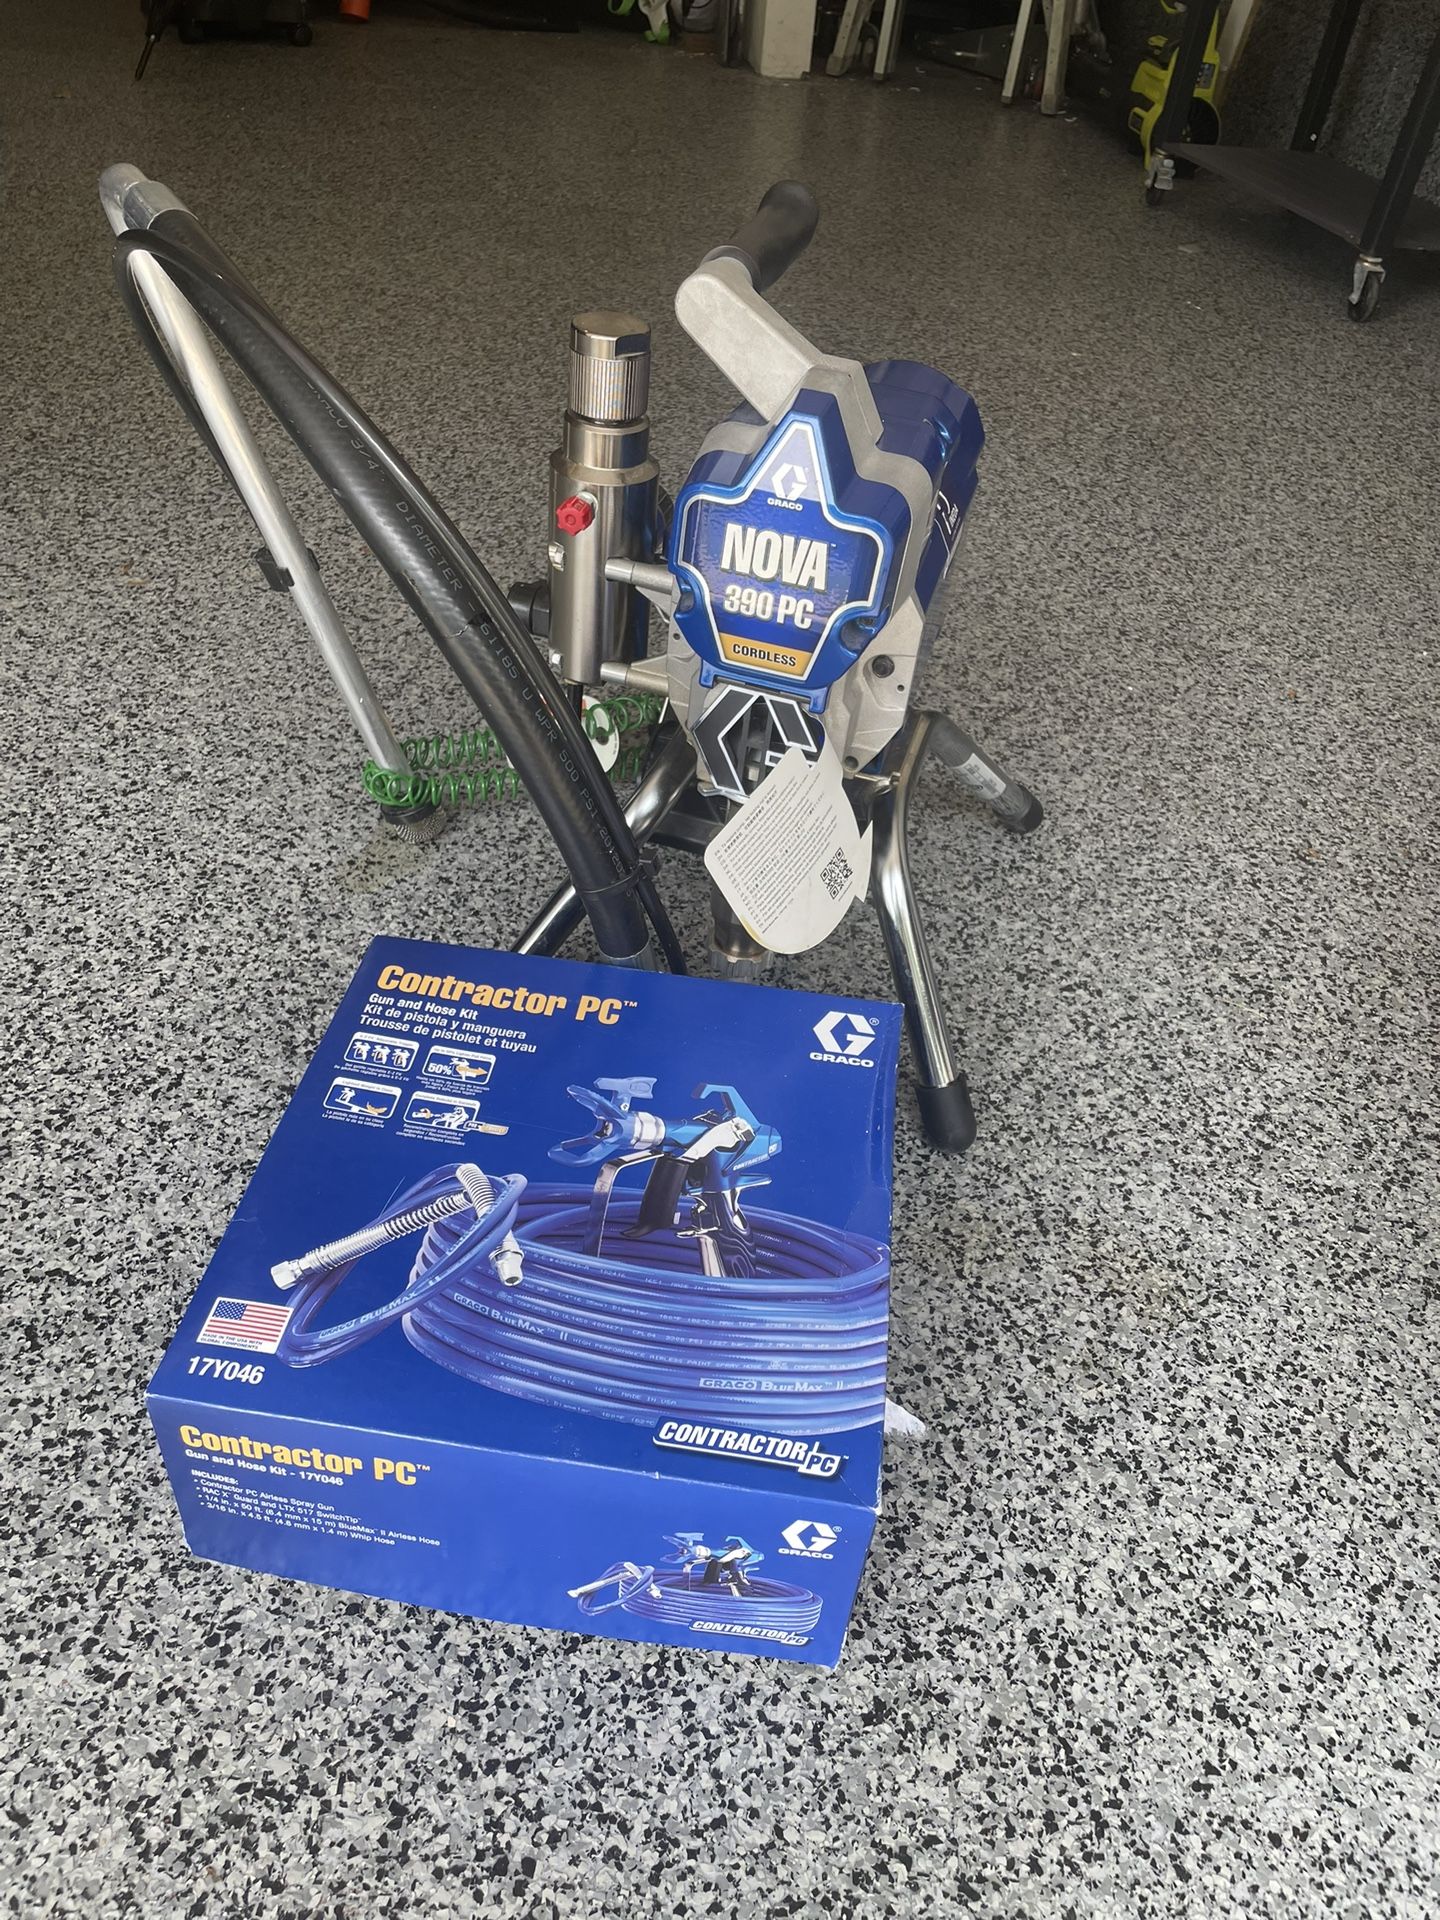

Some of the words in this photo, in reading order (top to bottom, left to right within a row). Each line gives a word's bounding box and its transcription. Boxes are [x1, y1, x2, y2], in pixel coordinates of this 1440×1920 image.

[767, 497, 803, 511] GRACO
[720, 523, 828, 592] NOVA
[723, 584, 771, 621] 390
[776, 594, 814, 630] PC
[396, 501, 462, 592] DIAMETER
[480, 623, 518, 679] 61185
[535, 708, 558, 742] WPR
[559, 750, 580, 783] 500
[580, 788, 598, 819] PSI
[732, 644, 796, 667] CORDLESS
[369, 993, 394, 1006] Gun
[397, 998, 422, 1010] and
[425, 1003, 457, 1017] Hose
[459, 1008, 479, 1020] Kit
[377, 964, 567, 1017] Contractor
[360, 1015, 410, 1032] Trousse
[413, 1024, 430, 1036] de
[432, 1029, 481, 1046] pistolet
[484, 1038, 497, 1047] et
[500, 1039, 537, 1053] tuyau
[363, 1004, 383, 1016] Kit
[385, 1006, 401, 1018] de
[403, 1011, 447, 1027] pistola
[450, 1020, 459, 1030] y
[462, 1022, 527, 1040] manguera
[427, 1062, 452, 1075] 50%
[809, 1052, 874, 1068] GRACO
[222, 1340, 259, 1350] COMPONENTS
[455, 1294, 488, 1313] GRACO
[560, 1331, 568, 1341] II
[594, 1343, 645, 1359] PERFORMANCE
[650, 1354, 683, 1364] AIRLESS
[686, 1359, 711, 1367] PAINT
[186, 1355, 266, 1386] 17Y046
[703, 1379, 755, 1390] GRACO
[836, 1380, 844, 1390] II
[621, 1391, 641, 1400] MADE
[179, 1425, 362, 1476] Contractor
[658, 1420, 810, 1461] CONTRACTOR
[805, 1453, 838, 1474] PC
[185, 1449, 209, 1461] Gun
[212, 1456, 234, 1466] and
[237, 1460, 267, 1472] Hose
[269, 1465, 287, 1476] Kit
[299, 1471, 344, 1486] 17Y046
[191, 1469, 239, 1485] INCLUDES:
[200, 1479, 244, 1494] Contractor
[245, 1488, 258, 1497] PC
[260, 1492, 289, 1504] Airless
[290, 1498, 315, 1509] Spray
[317, 1502, 335, 1512] Gun
[202, 1487, 220, 1496] RAC
[233, 1494, 259, 1505] Guard
[261, 1500, 277, 1508] and
[278, 1503, 296, 1512] LTX
[205, 1495, 219, 1503] 1/4
[241, 1503, 252, 1511] 50
[284, 1513, 301, 1521] mm
[325, 1520, 336, 1528] m)
[388, 1531, 417, 1542] Airless
[419, 1536, 441, 1546] Hose
[228, 1507, 239, 1515] in.
[294, 1522, 311, 1531] mm
[321, 1526, 334, 1535] 1.4
[336, 1529, 348, 1538] m)
[350, 1531, 372, 1542] Whip
[374, 1536, 395, 1546] Hose
[778, 1548, 834, 1560] GRACO
[692, 1620, 789, 1640] CONTRACTOR
